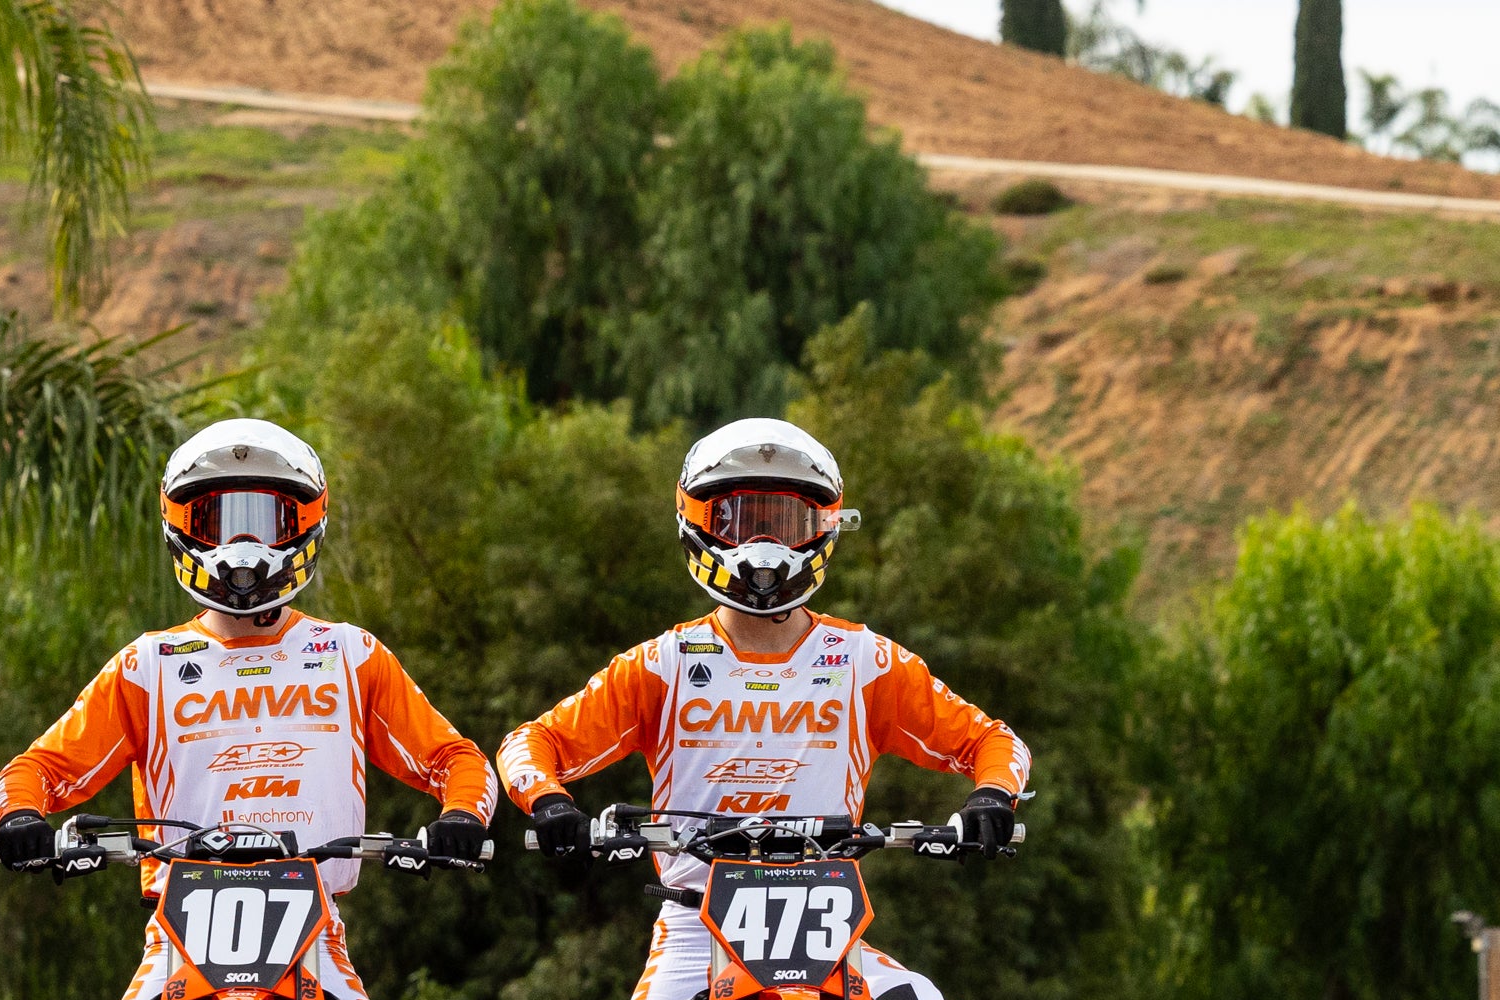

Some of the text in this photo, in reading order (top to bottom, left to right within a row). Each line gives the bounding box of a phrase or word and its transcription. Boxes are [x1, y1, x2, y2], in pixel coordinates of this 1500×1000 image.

[302, 655, 338, 672] SMX
[811, 654, 850, 668] AMA
[811, 671, 848, 687] SMX
[174, 683, 339, 727] CANVAS
[679, 698, 843, 734] CANVAS
[224, 776, 301, 801] KTM
[716, 791, 791, 813] KTM
[238, 808, 314, 825] synchrony
[608, 847, 644, 861] ASV
[919, 842, 956, 854] ASV
[66, 856, 102, 872] ASV
[388, 855, 426, 870] ASV
[223, 869, 271, 877] MONSTER
[181, 887, 314, 966] 107
[720, 886, 853, 961] 473
[224, 973, 260, 982] SKDA
[773, 970, 807, 980] SKDA
[166, 979, 187, 990] CN
[715, 977, 735, 989] CN
[167, 989, 186, 1000] VS
[715, 988, 734, 999] VS
